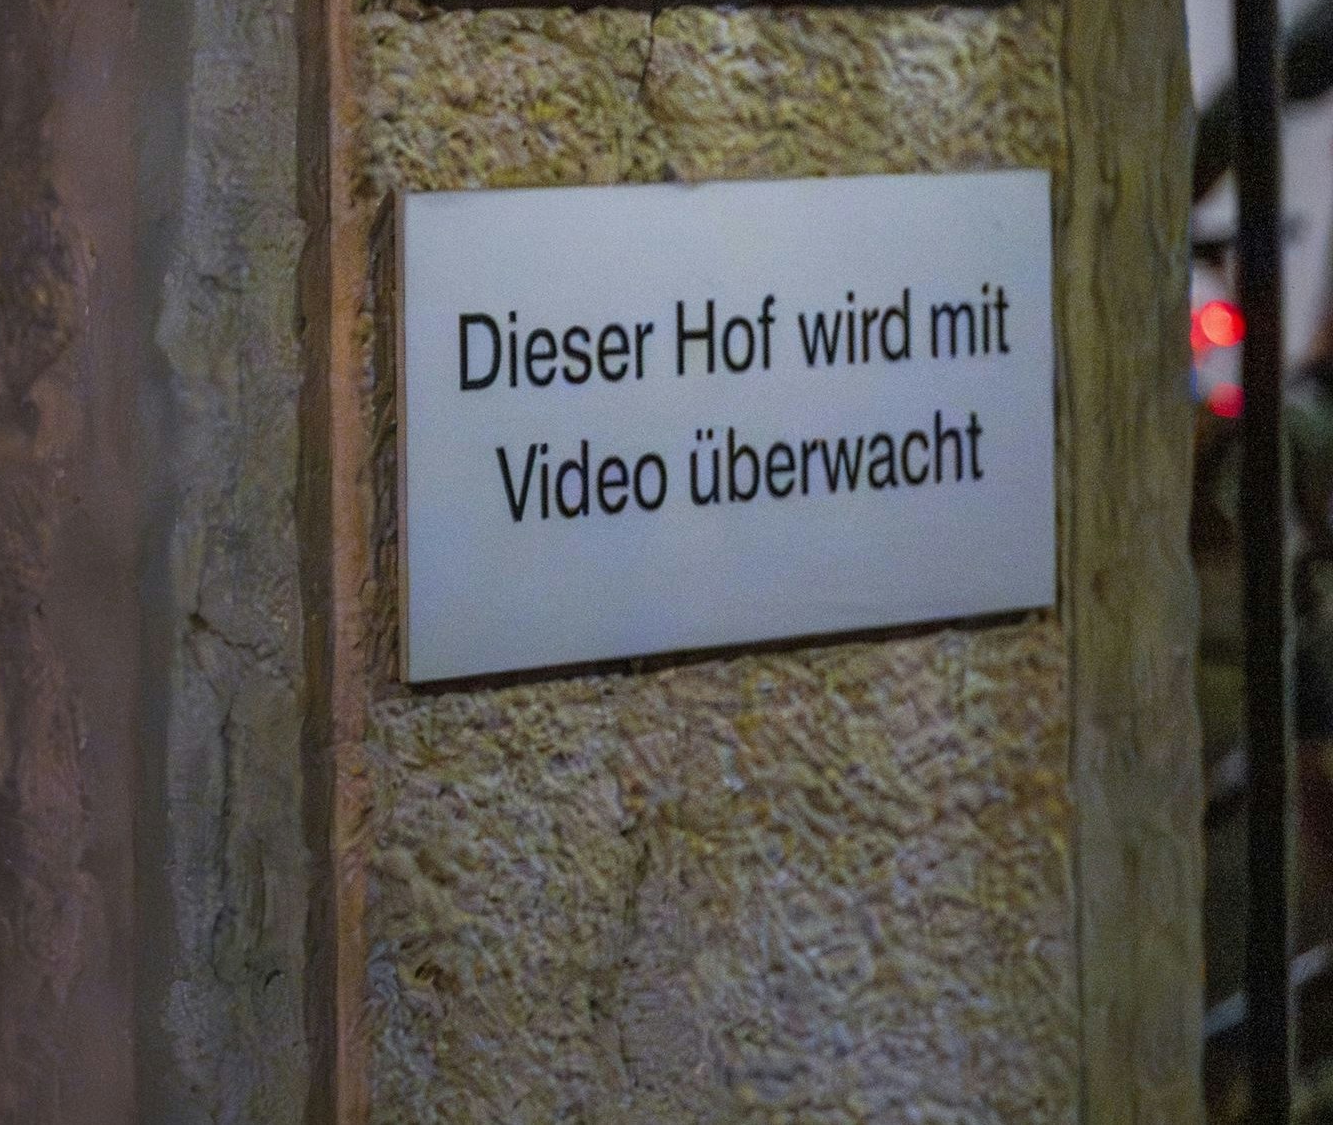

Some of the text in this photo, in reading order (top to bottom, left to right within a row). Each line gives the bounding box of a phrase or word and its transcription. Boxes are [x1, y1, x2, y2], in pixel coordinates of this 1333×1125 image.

[458, 282, 1010, 392] Dieser Hof wird mit
[496, 410, 984, 523] Video überwacht
